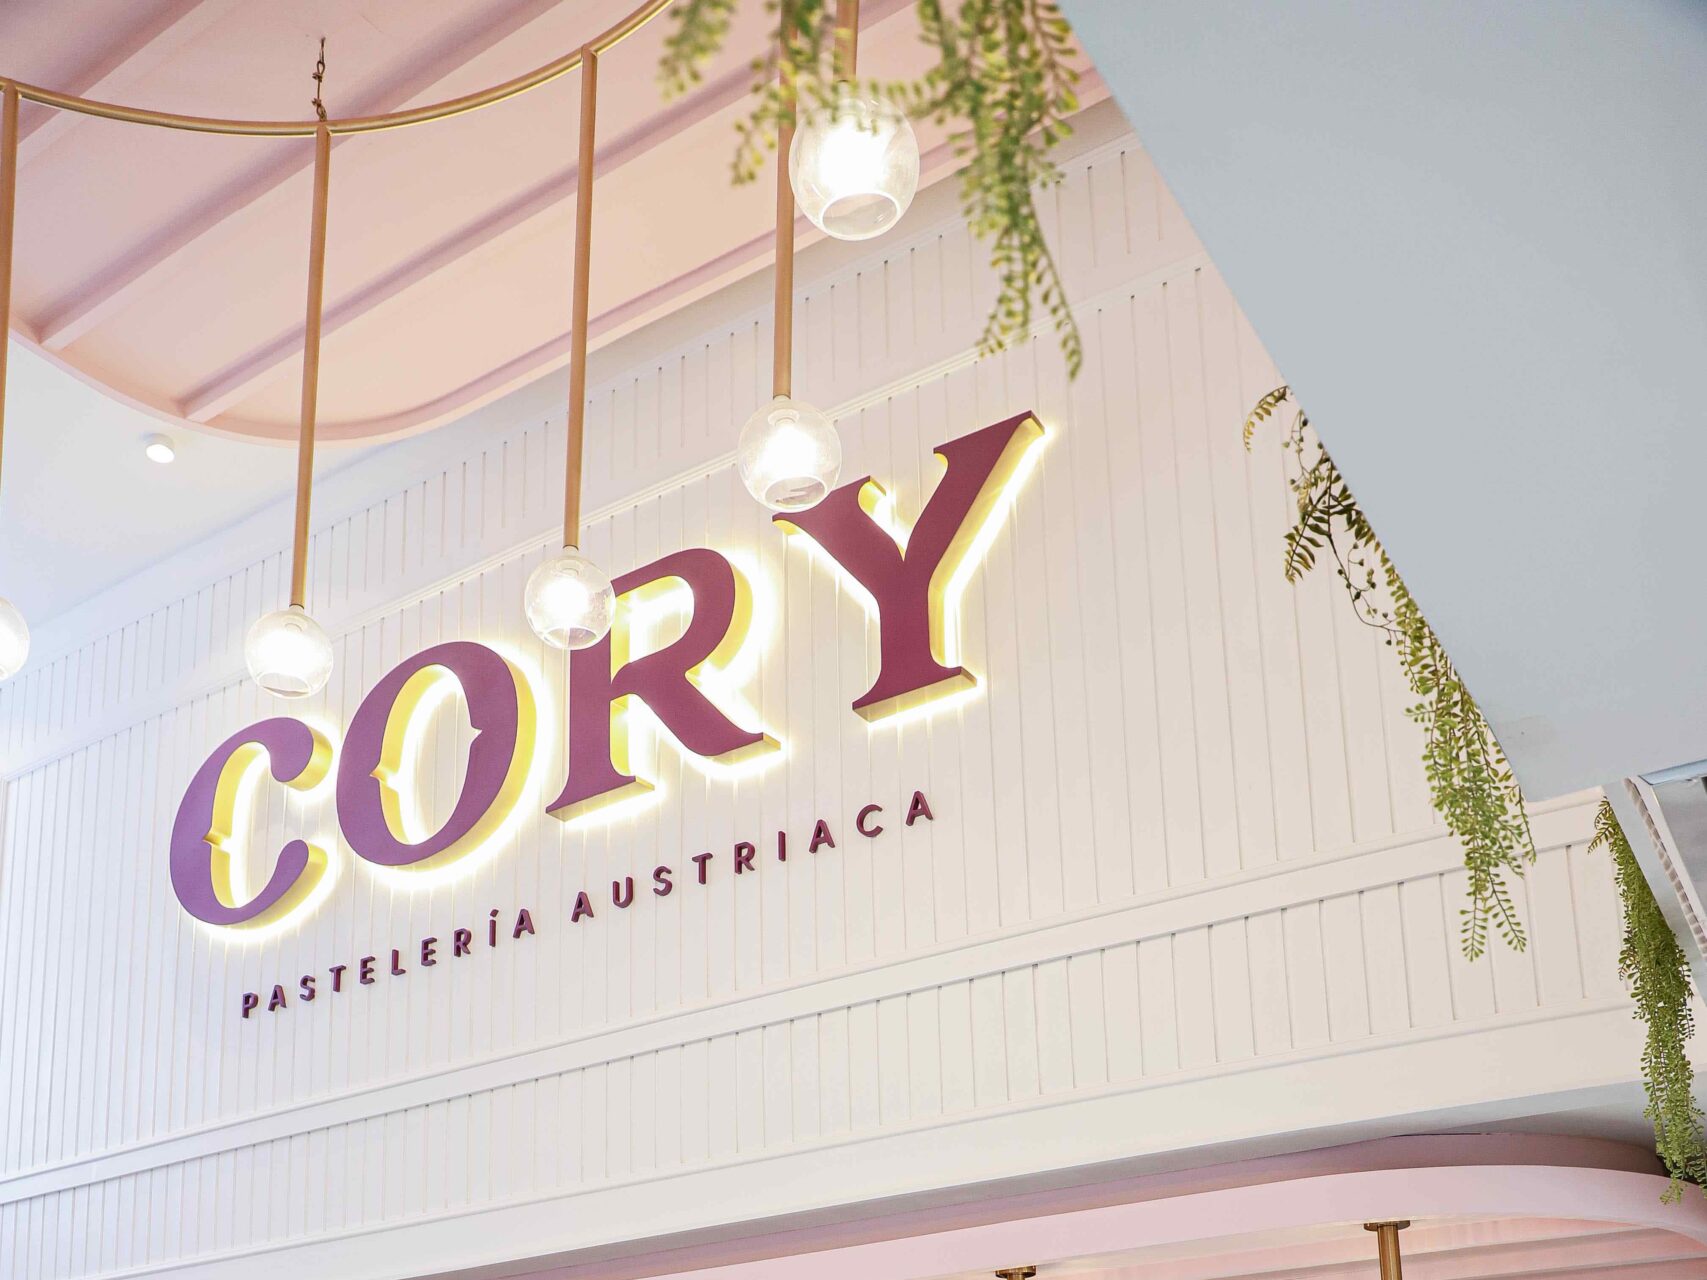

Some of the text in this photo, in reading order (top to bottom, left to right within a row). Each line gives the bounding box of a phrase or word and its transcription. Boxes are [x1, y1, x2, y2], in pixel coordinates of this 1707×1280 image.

[169, 409, 1046, 928] CORY
[241, 790, 935, 1020] PASTELERÍA AUSTRIACA
